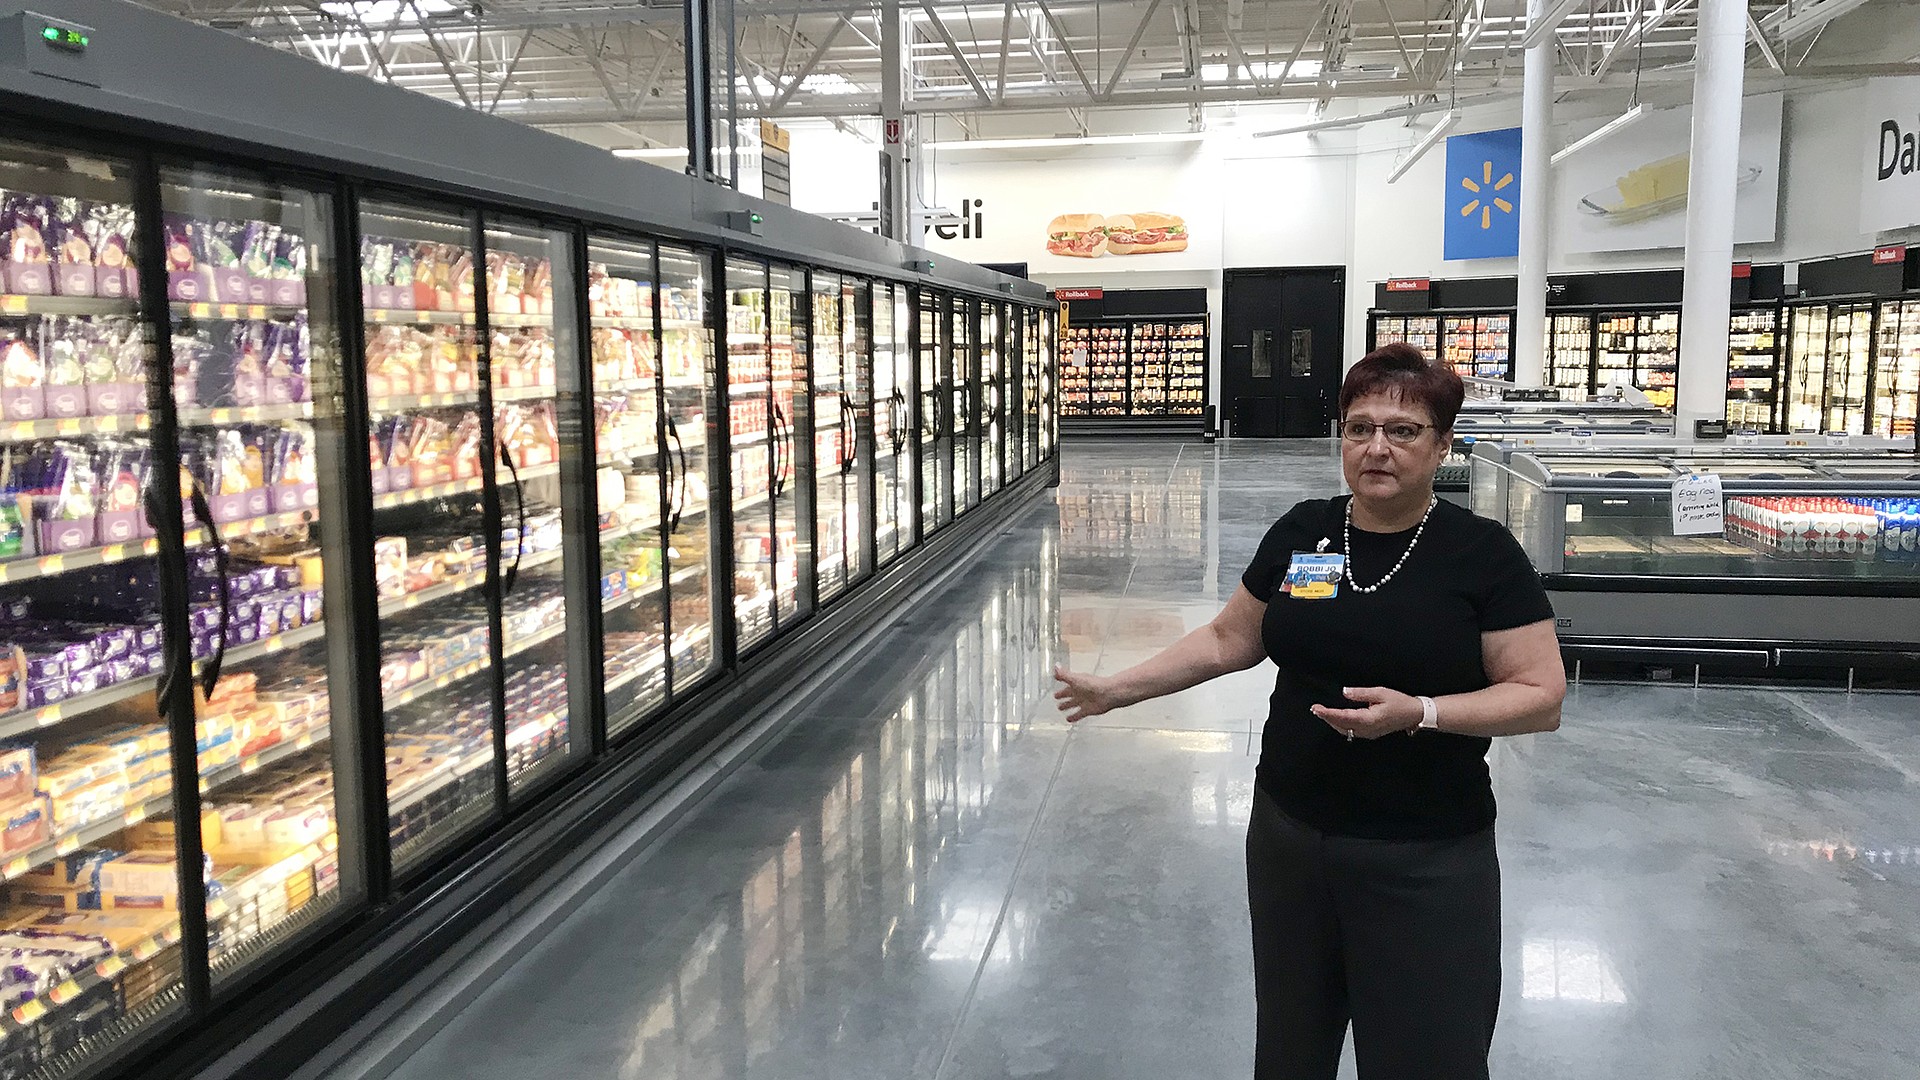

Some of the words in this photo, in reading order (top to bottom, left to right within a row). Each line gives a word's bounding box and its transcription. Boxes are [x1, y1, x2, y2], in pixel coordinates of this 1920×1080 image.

[1878, 119, 1920, 181] Da
[924, 199, 983, 240] eli
[1678, 488, 1698, 502] Egg
[1296, 565, 1324, 573] BOBBI
[1325, 565, 1337, 573] JO
